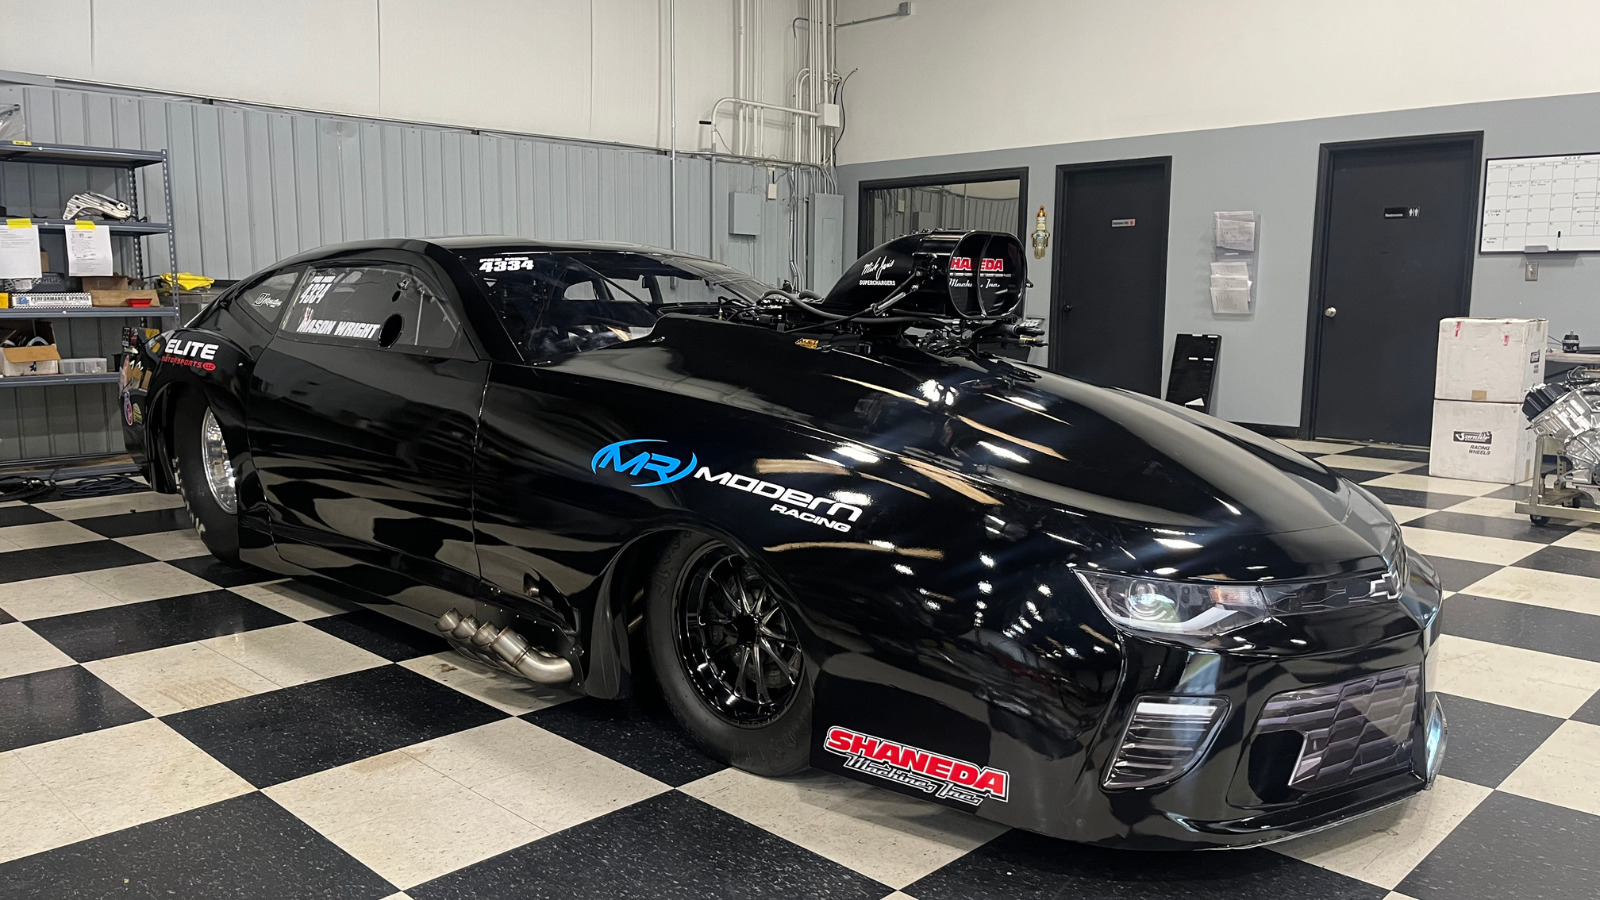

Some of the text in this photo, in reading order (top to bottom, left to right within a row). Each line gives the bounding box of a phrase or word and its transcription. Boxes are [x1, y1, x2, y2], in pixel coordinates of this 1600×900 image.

[479, 260, 534, 272] 4334
[950, 257, 1004, 271] HAEDA
[299, 283, 333, 303] 4334
[297, 320, 380, 338] MASON WRIGHT
[165, 339, 219, 360] ELITE
[162, 355, 202, 368] MOTORSPORTS
[598, 445, 682, 482] MR
[770, 503, 851, 532] RACING
[827, 728, 1006, 797] SHANEDA
